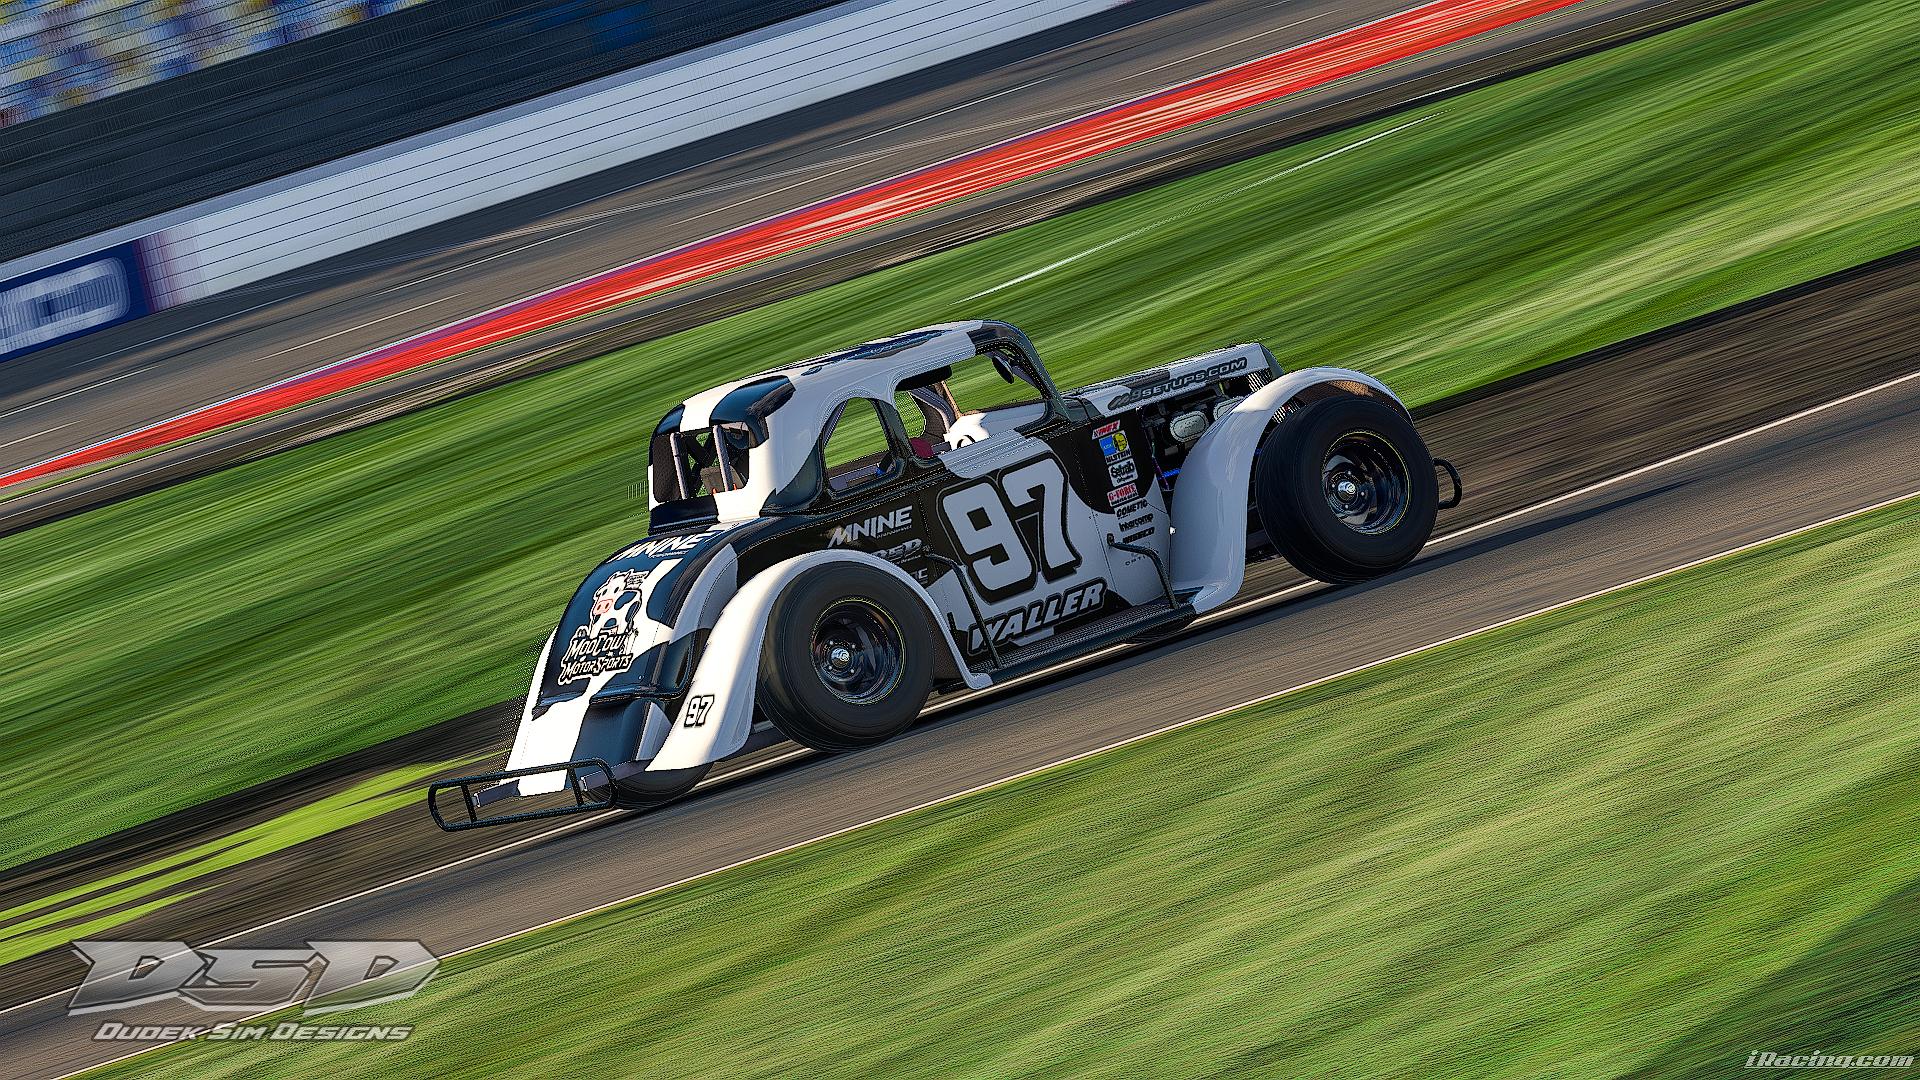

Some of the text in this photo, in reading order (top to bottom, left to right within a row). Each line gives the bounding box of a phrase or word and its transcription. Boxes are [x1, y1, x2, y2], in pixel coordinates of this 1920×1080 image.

[827, 505, 912, 549] MNINE
[938, 458, 1082, 600] 97
[967, 577, 1108, 656] WALLER
[684, 694, 715, 728] 97
